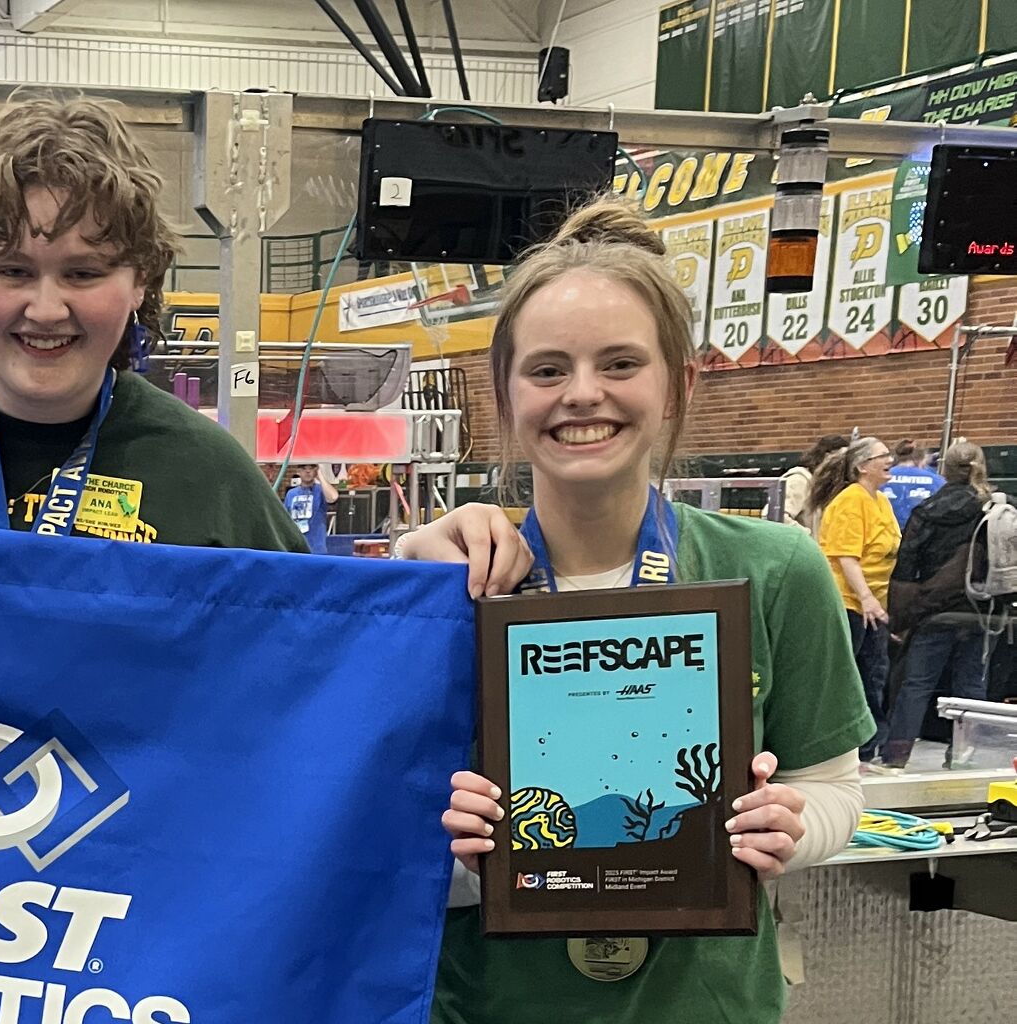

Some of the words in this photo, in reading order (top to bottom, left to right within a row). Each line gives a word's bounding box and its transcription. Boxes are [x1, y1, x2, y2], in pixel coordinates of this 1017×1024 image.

[927, 88, 951, 106] HH
[923, 107, 952, 124] THE
[390, 183, 401, 199] 2
[967, 241, 1014, 256] Awards
[845, 303, 875, 334] 24
[917, 295, 949, 325] 30
[724, 321, 749, 348] 20
[783, 313, 809, 341] 22
[234, 368, 255, 389] F6
[90, 498, 112, 509] ANA
[521, 634, 704, 675] REEFSCAPE
[616, 684, 656, 696] HAAS
